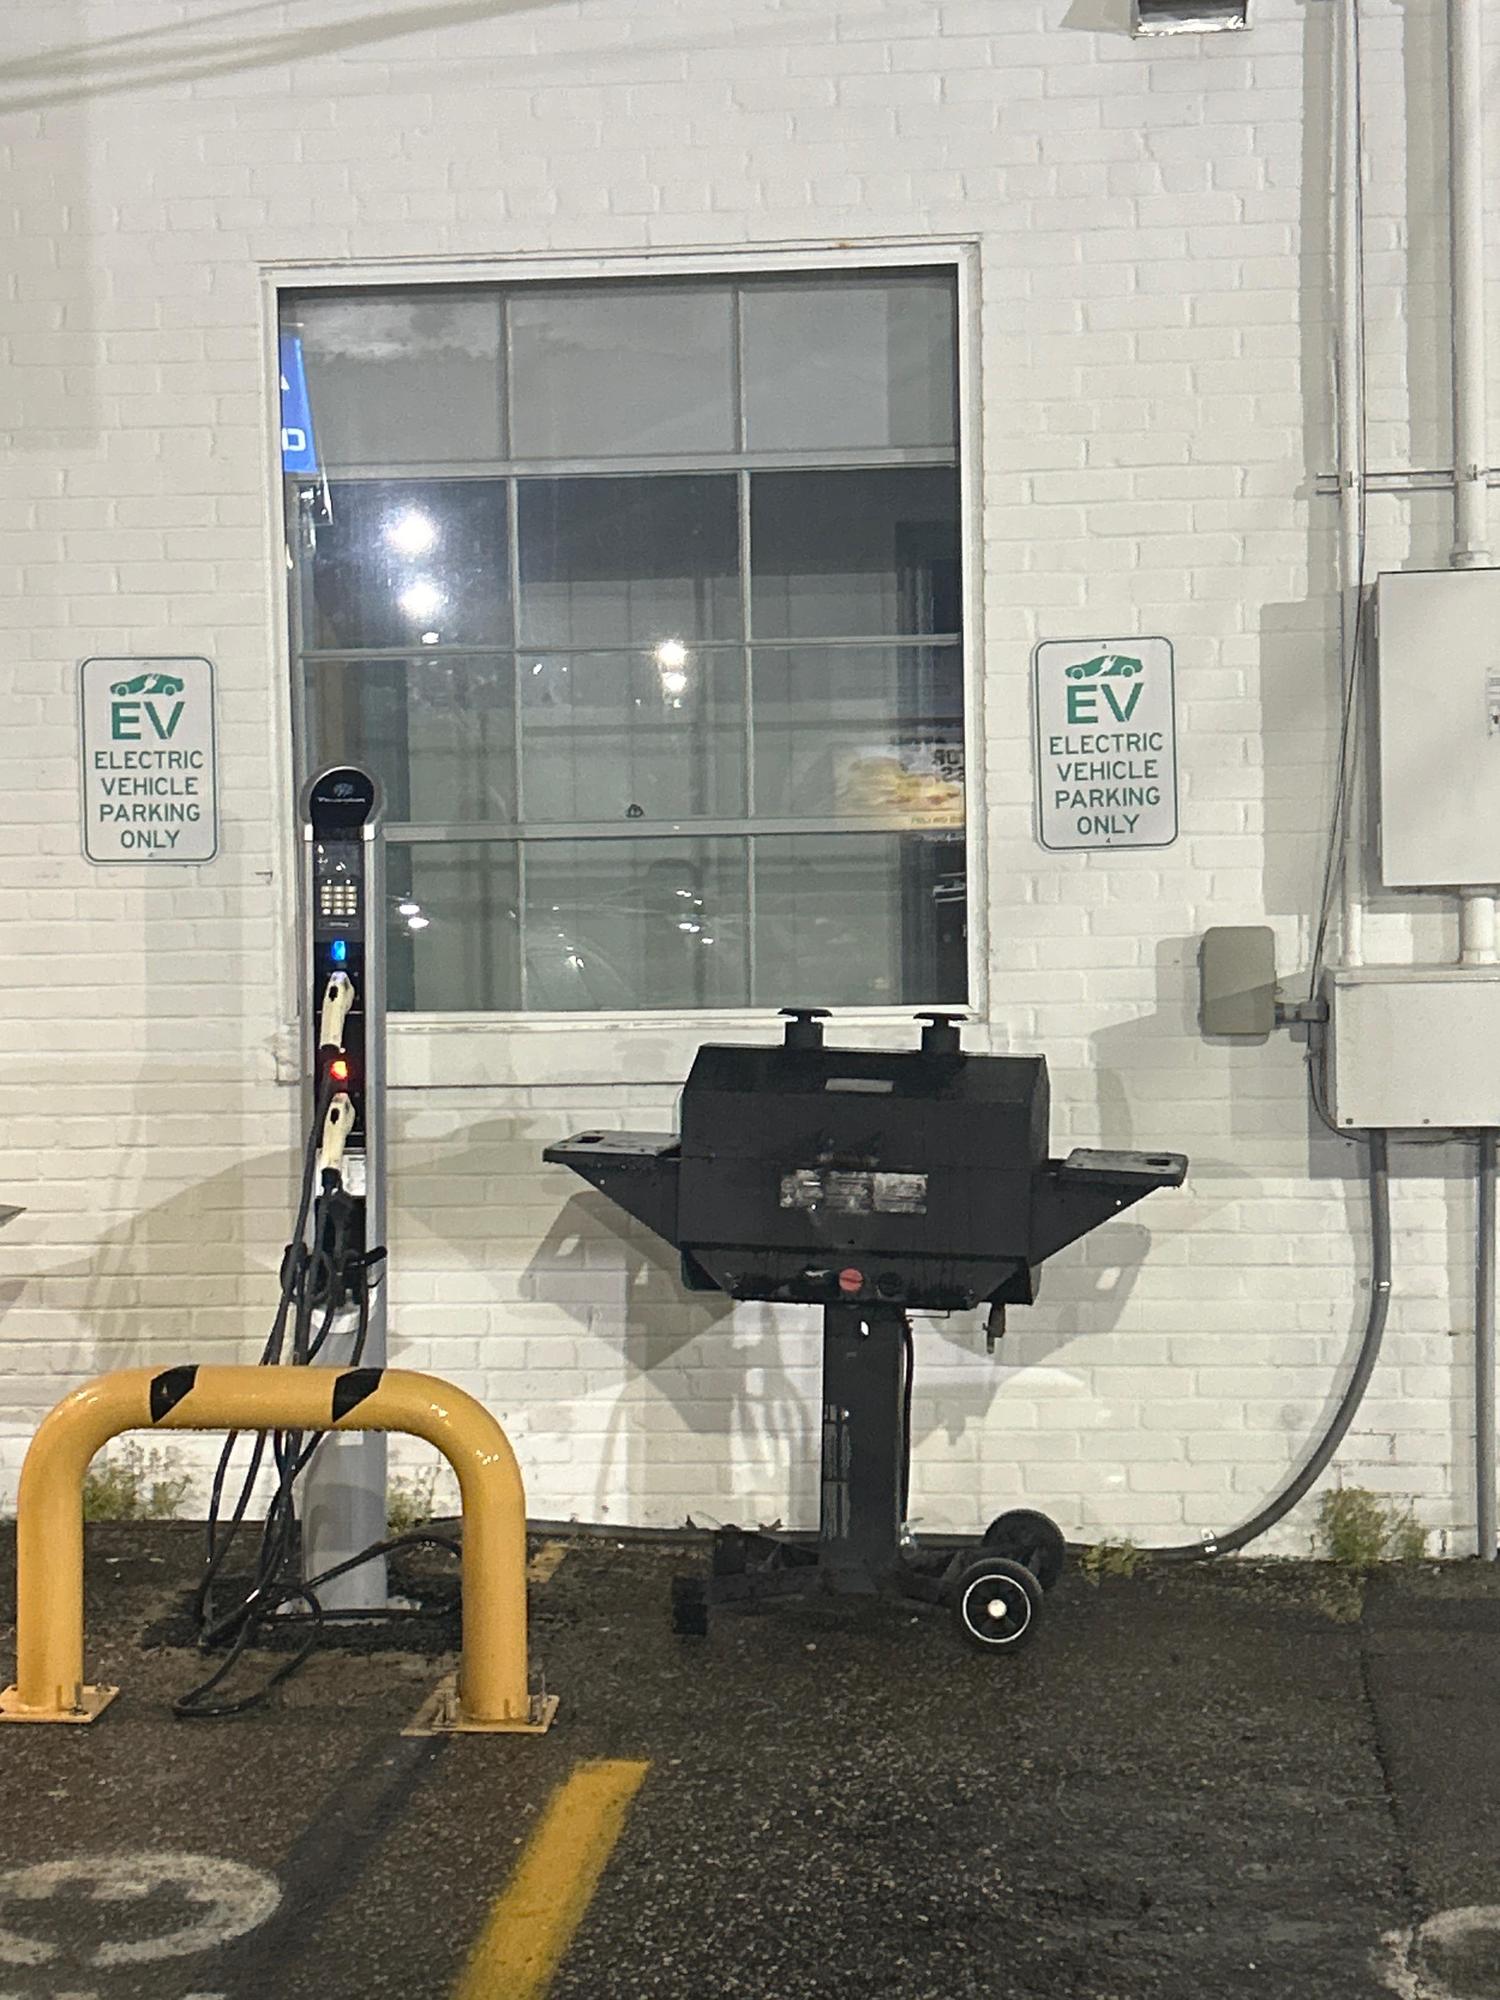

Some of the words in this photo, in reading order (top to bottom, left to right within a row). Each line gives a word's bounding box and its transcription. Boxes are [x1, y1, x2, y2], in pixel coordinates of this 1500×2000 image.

[1067, 682, 1144, 724] EV
[111, 701, 186, 740] EV
[1049, 732, 1163, 755] ELECTRIC
[95, 751, 204, 769] ELECTRIC
[1056, 759, 1159, 782] VEHICLE
[100, 777, 199, 796] VEHICLE
[1055, 786, 1161, 809] PARKING
[99, 803, 200, 823] PARKING
[1076, 814, 1140, 835] ONLY
[120, 829, 180, 849] ONLY
